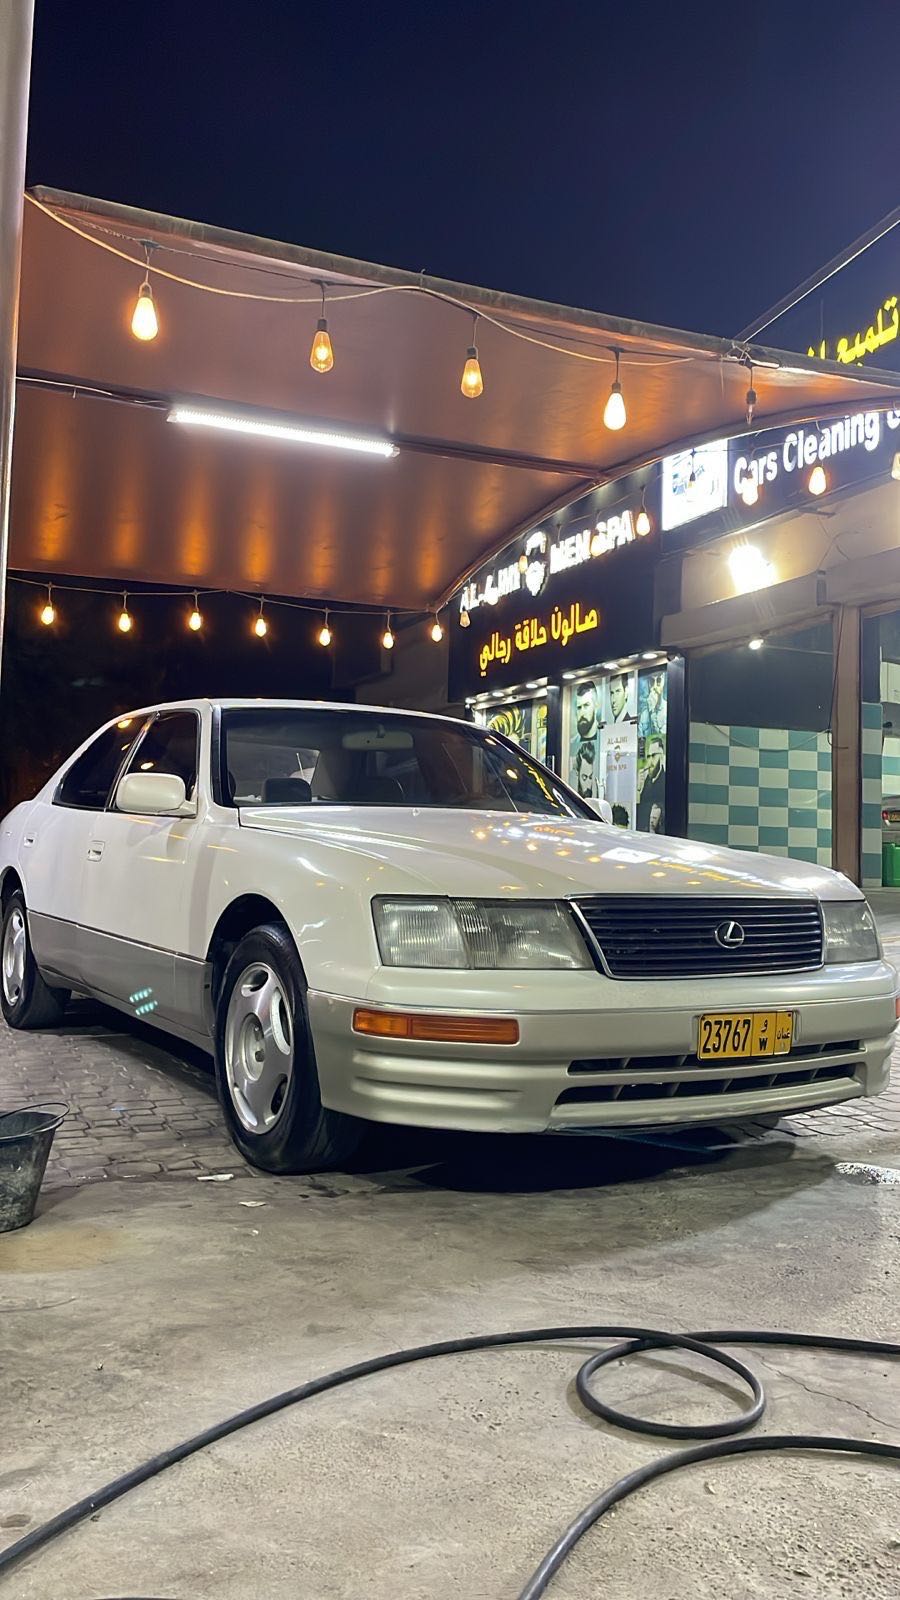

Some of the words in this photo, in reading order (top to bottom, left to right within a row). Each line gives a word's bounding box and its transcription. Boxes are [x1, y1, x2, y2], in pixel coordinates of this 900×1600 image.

[734, 451, 778, 494] Cars
[783, 411, 880, 472] Cleaning
[550, 529, 591, 574] MEN
[593, 510, 636, 554] SPA
[515, 618, 547, 651] حلاقة
[551, 603, 598, 646] صالون
[479, 632, 511, 677] رجالي
[702, 1018, 751, 1054] 23767
[759, 1038, 768, 1052] W
